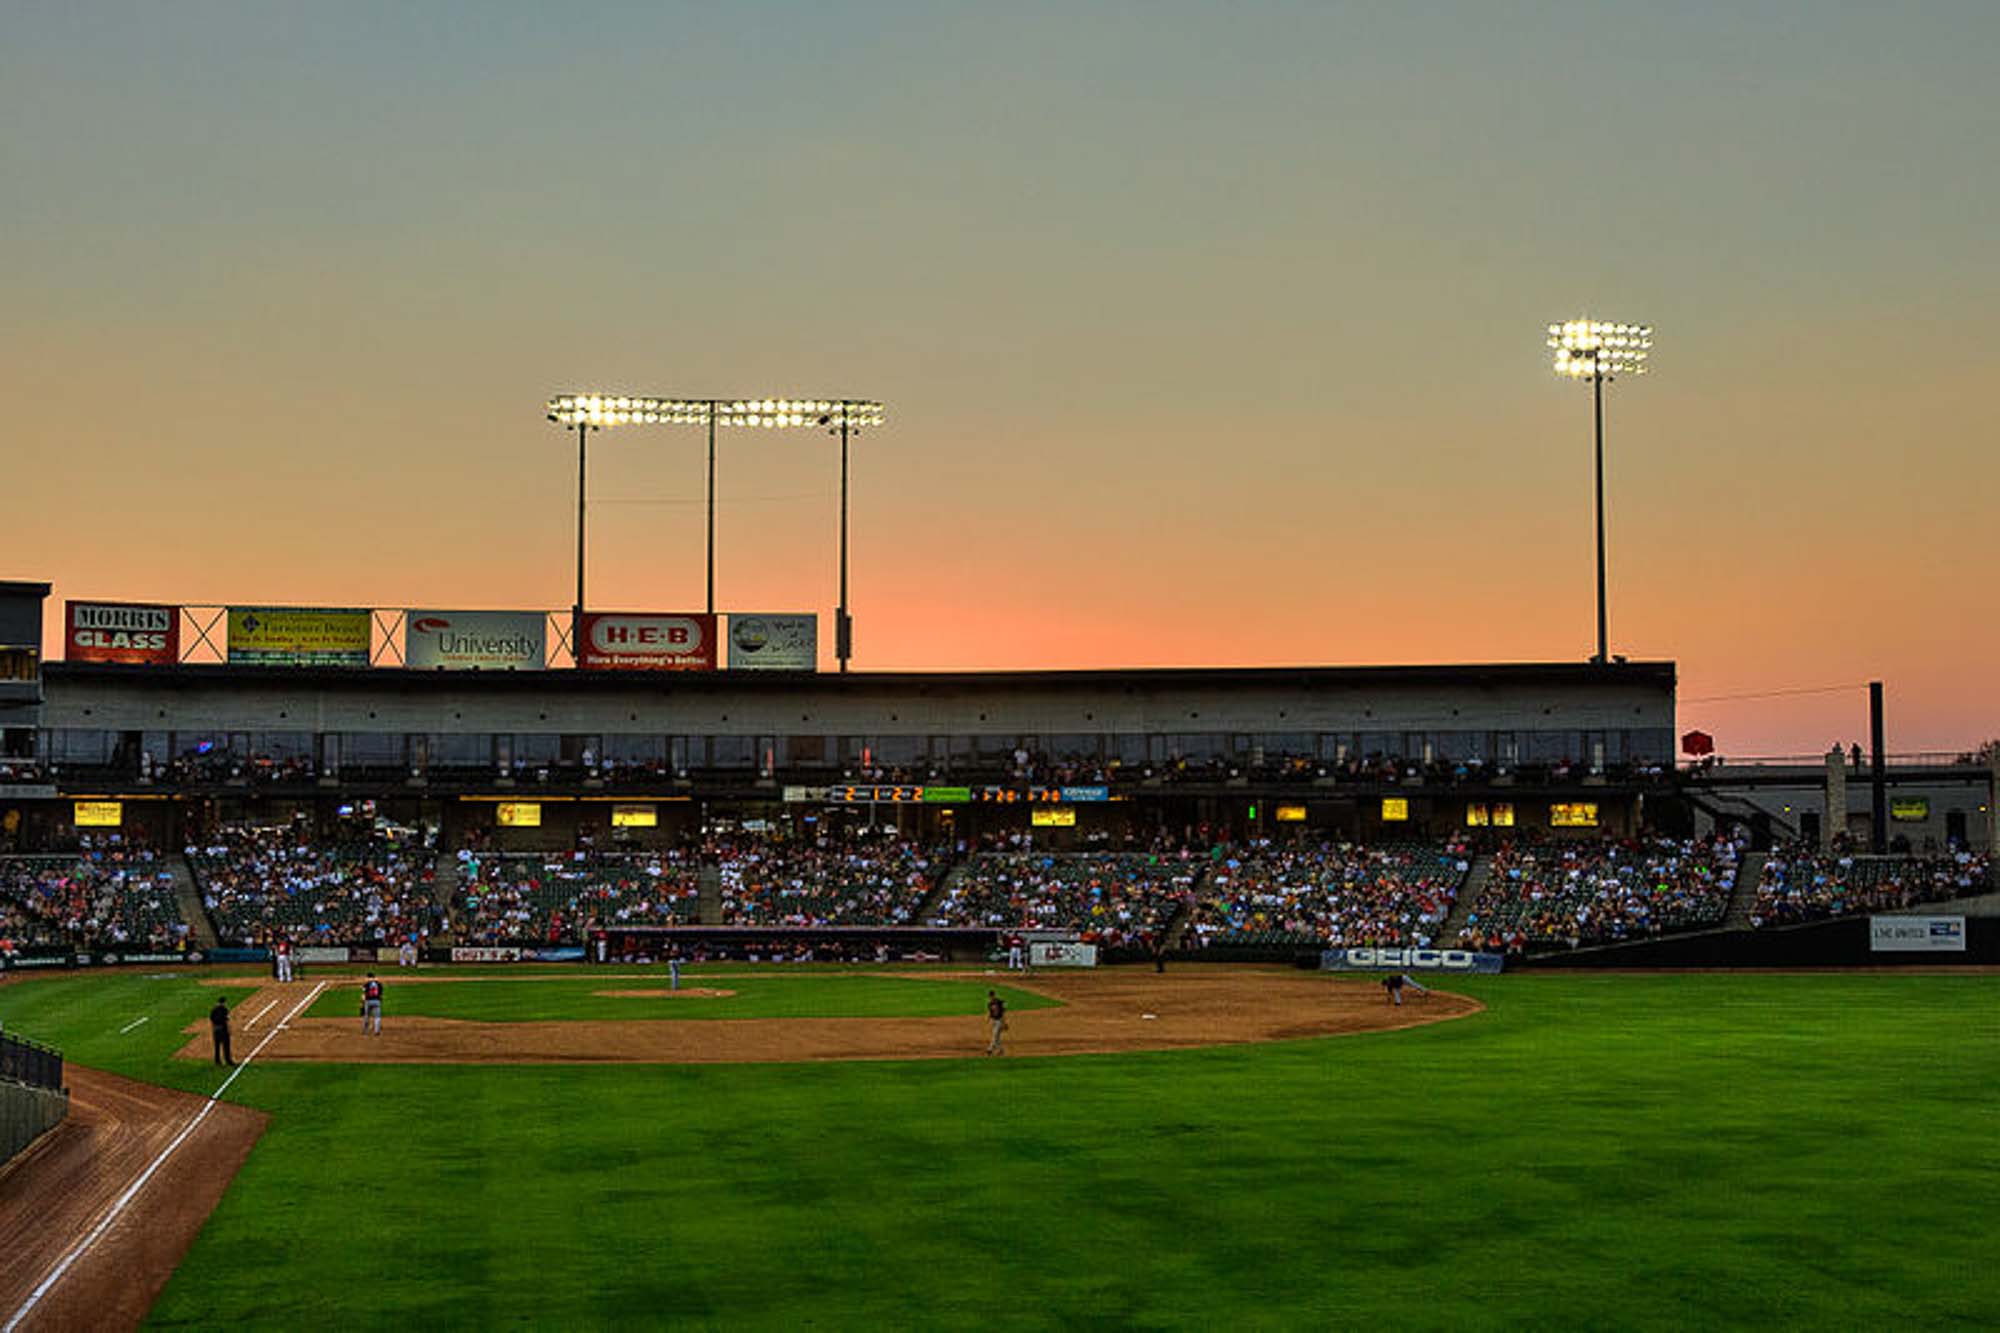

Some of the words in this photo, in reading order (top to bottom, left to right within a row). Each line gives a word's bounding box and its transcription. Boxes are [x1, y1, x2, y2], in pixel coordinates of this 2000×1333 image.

[79, 607, 167, 629] MORRIS
[74, 631, 166, 649] GLASS
[439, 632, 538, 660] University
[1347, 949, 1473, 968] GEICO
